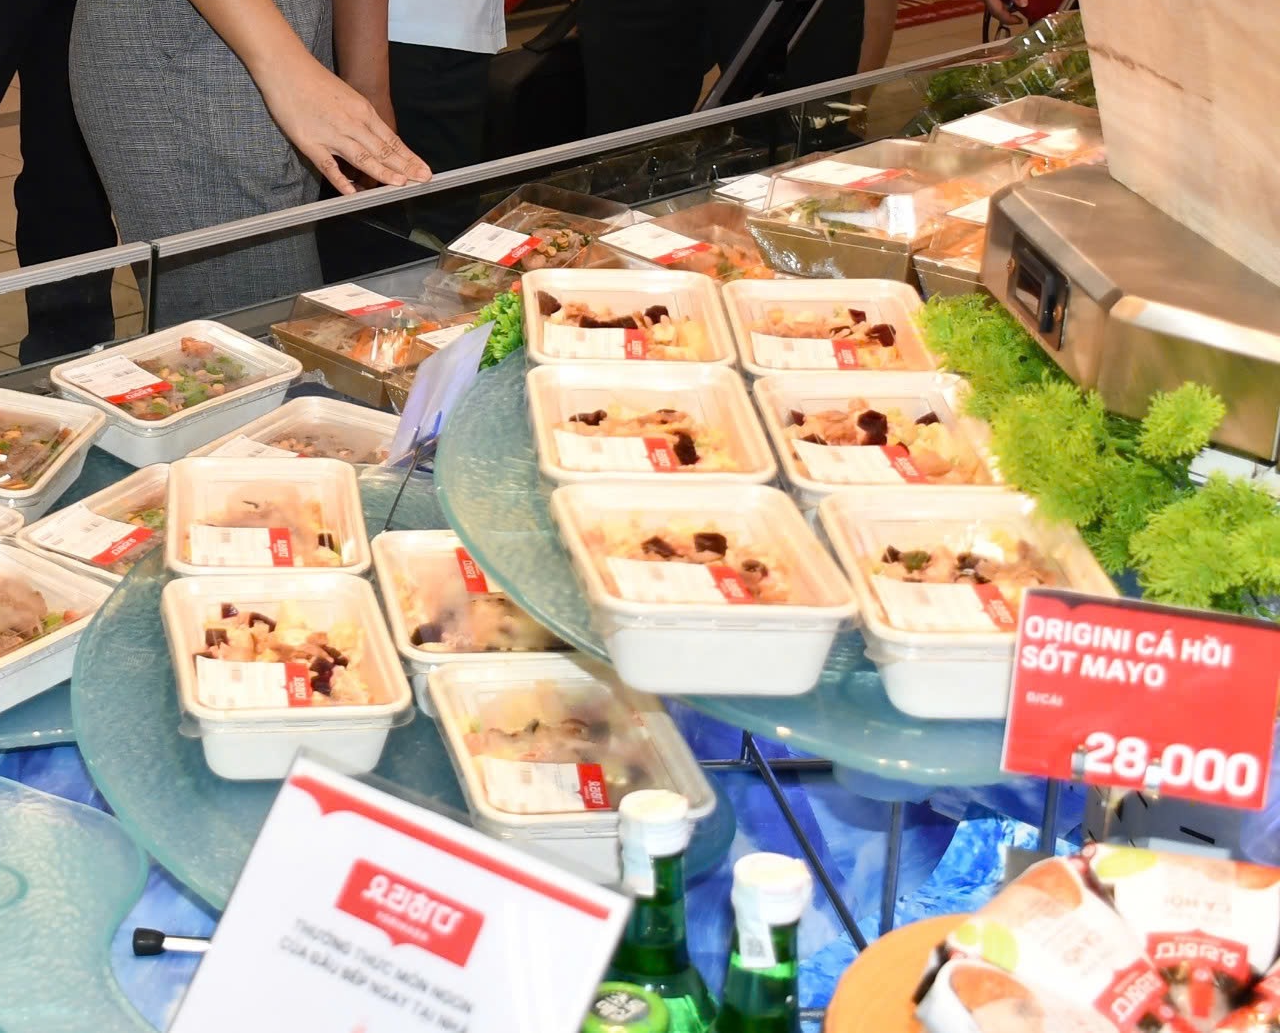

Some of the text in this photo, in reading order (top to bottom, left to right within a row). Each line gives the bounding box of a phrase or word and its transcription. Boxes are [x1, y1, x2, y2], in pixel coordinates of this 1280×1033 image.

[1021, 641, 1167, 688] SỐT MAYO
[1024, 615, 1233, 667] ORIGINI CÁ HỒI
